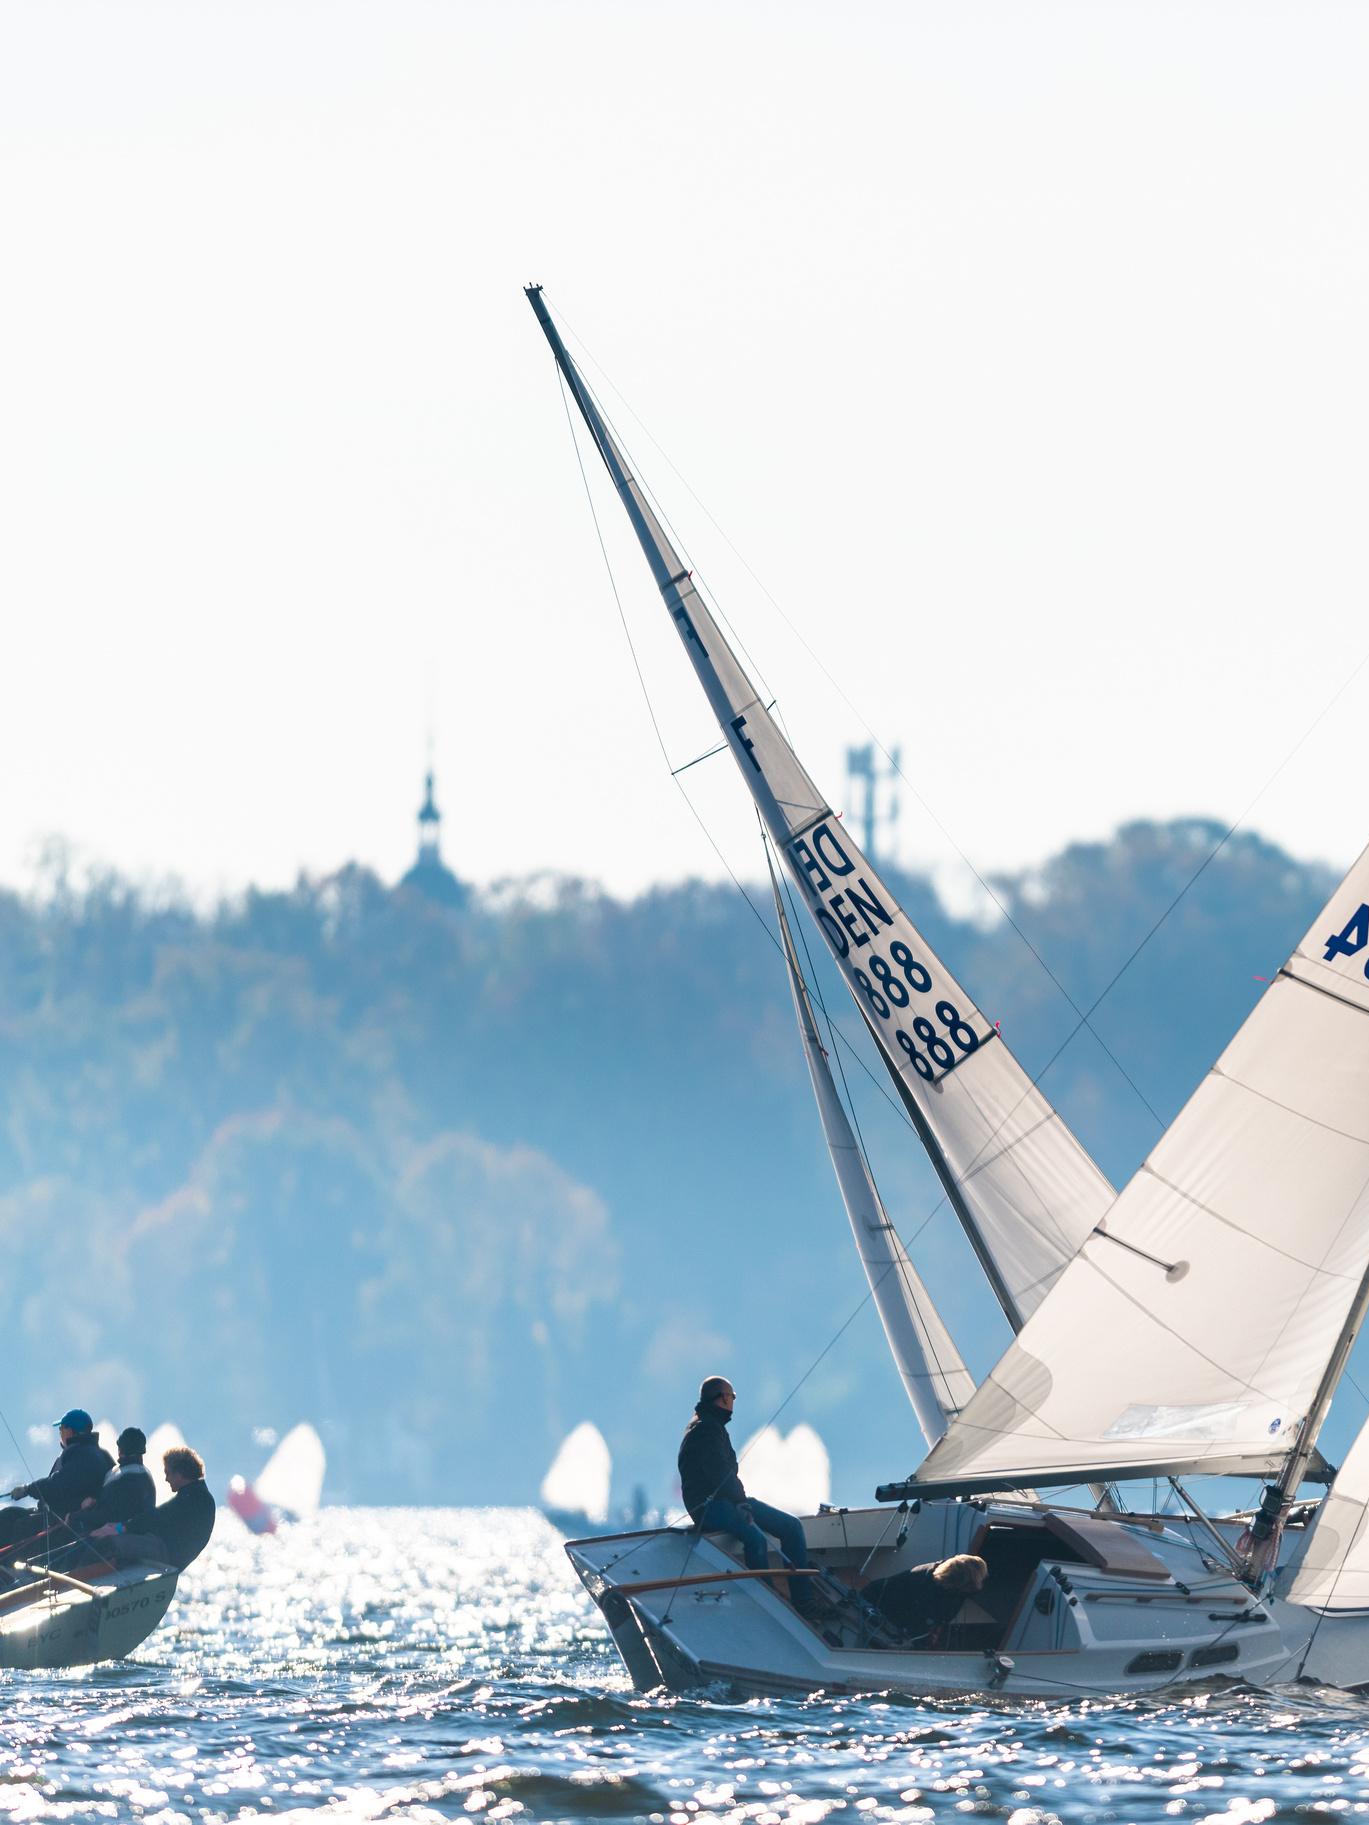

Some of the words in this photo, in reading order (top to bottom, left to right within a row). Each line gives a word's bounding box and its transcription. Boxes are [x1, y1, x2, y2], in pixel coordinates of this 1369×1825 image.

[730, 715, 762, 772] F
[816, 878, 894, 959] DEN
[853, 940, 932, 1020] 888
[896, 1001, 979, 1081] 888
